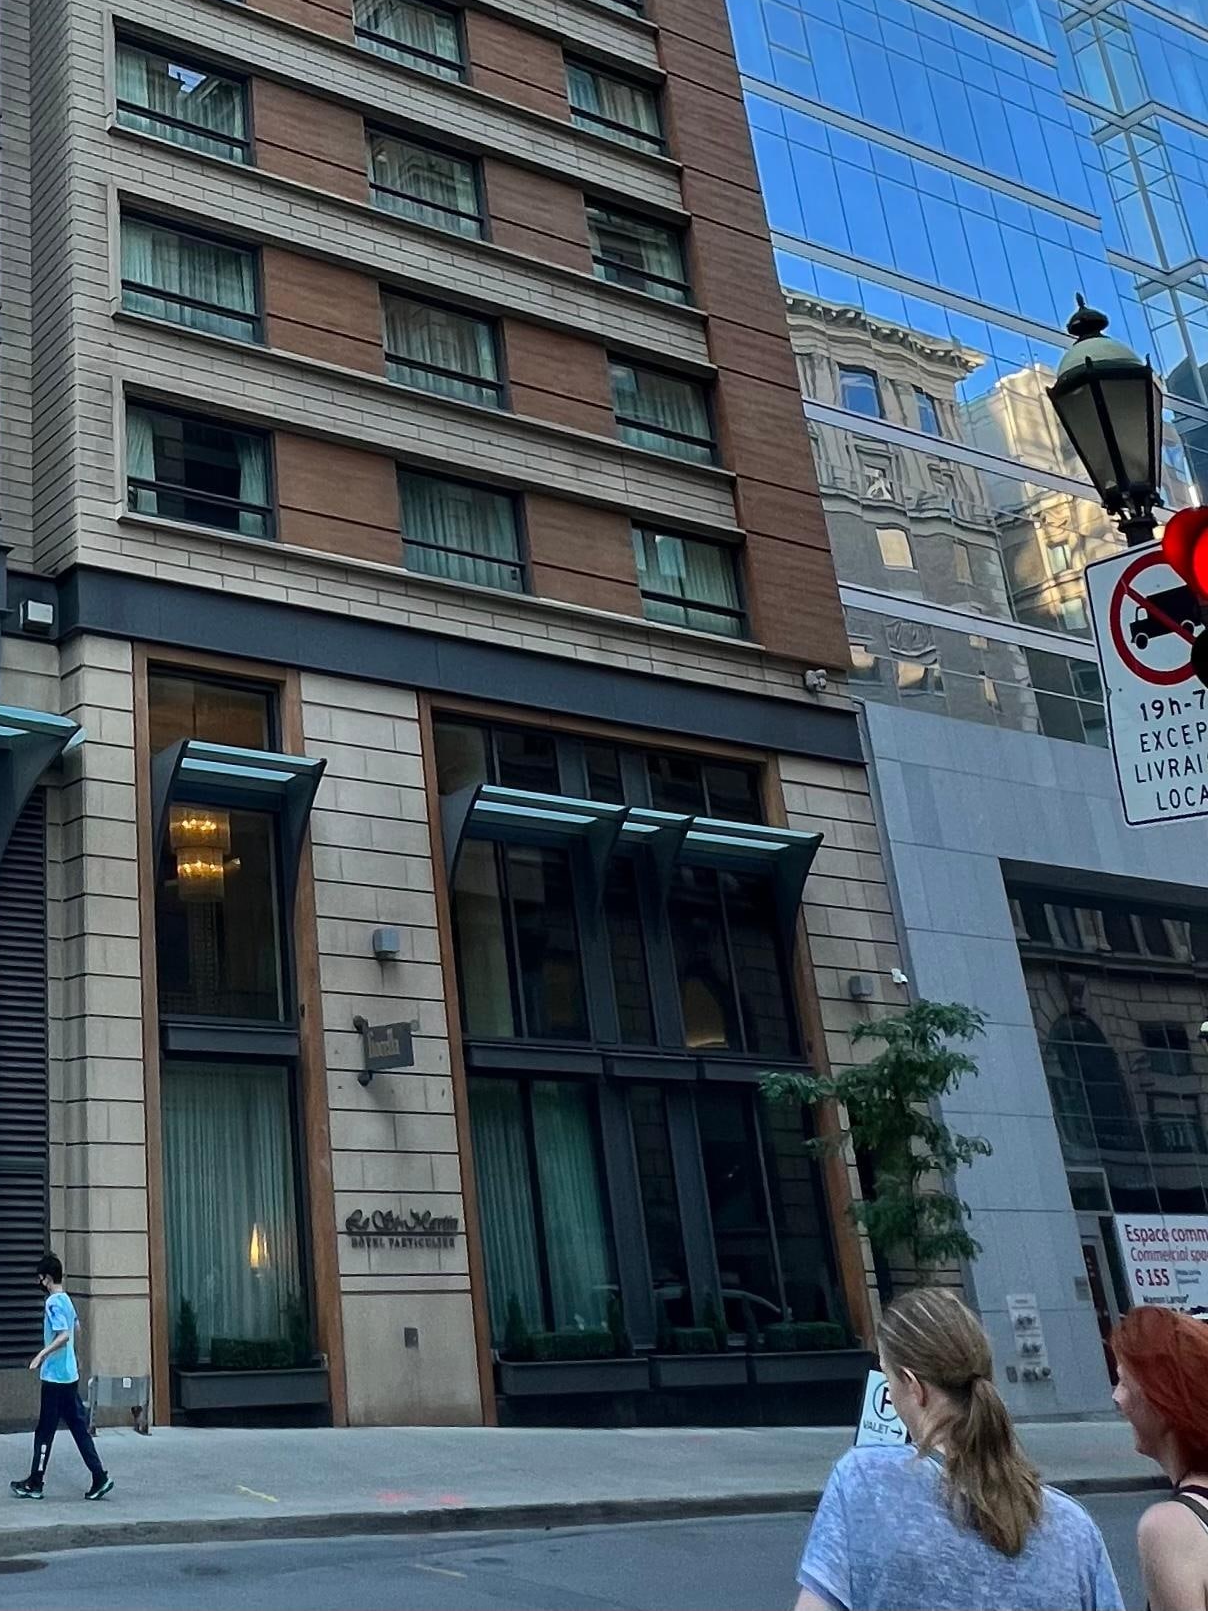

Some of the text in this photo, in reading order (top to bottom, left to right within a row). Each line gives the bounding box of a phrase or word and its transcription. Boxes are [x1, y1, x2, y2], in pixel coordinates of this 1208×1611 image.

[1140, 689, 1206, 722] 19h-7
[1139, 721, 1207, 753] EXCEP
[1134, 753, 1208, 783] LIVRAI
[388, 1236, 455, 1249] PARTICULIER
[1124, 1223, 1169, 1247] Espace
[1130, 1246, 1208, 1265] Commercial spa
[863, 1420, 890, 1435] VALET
